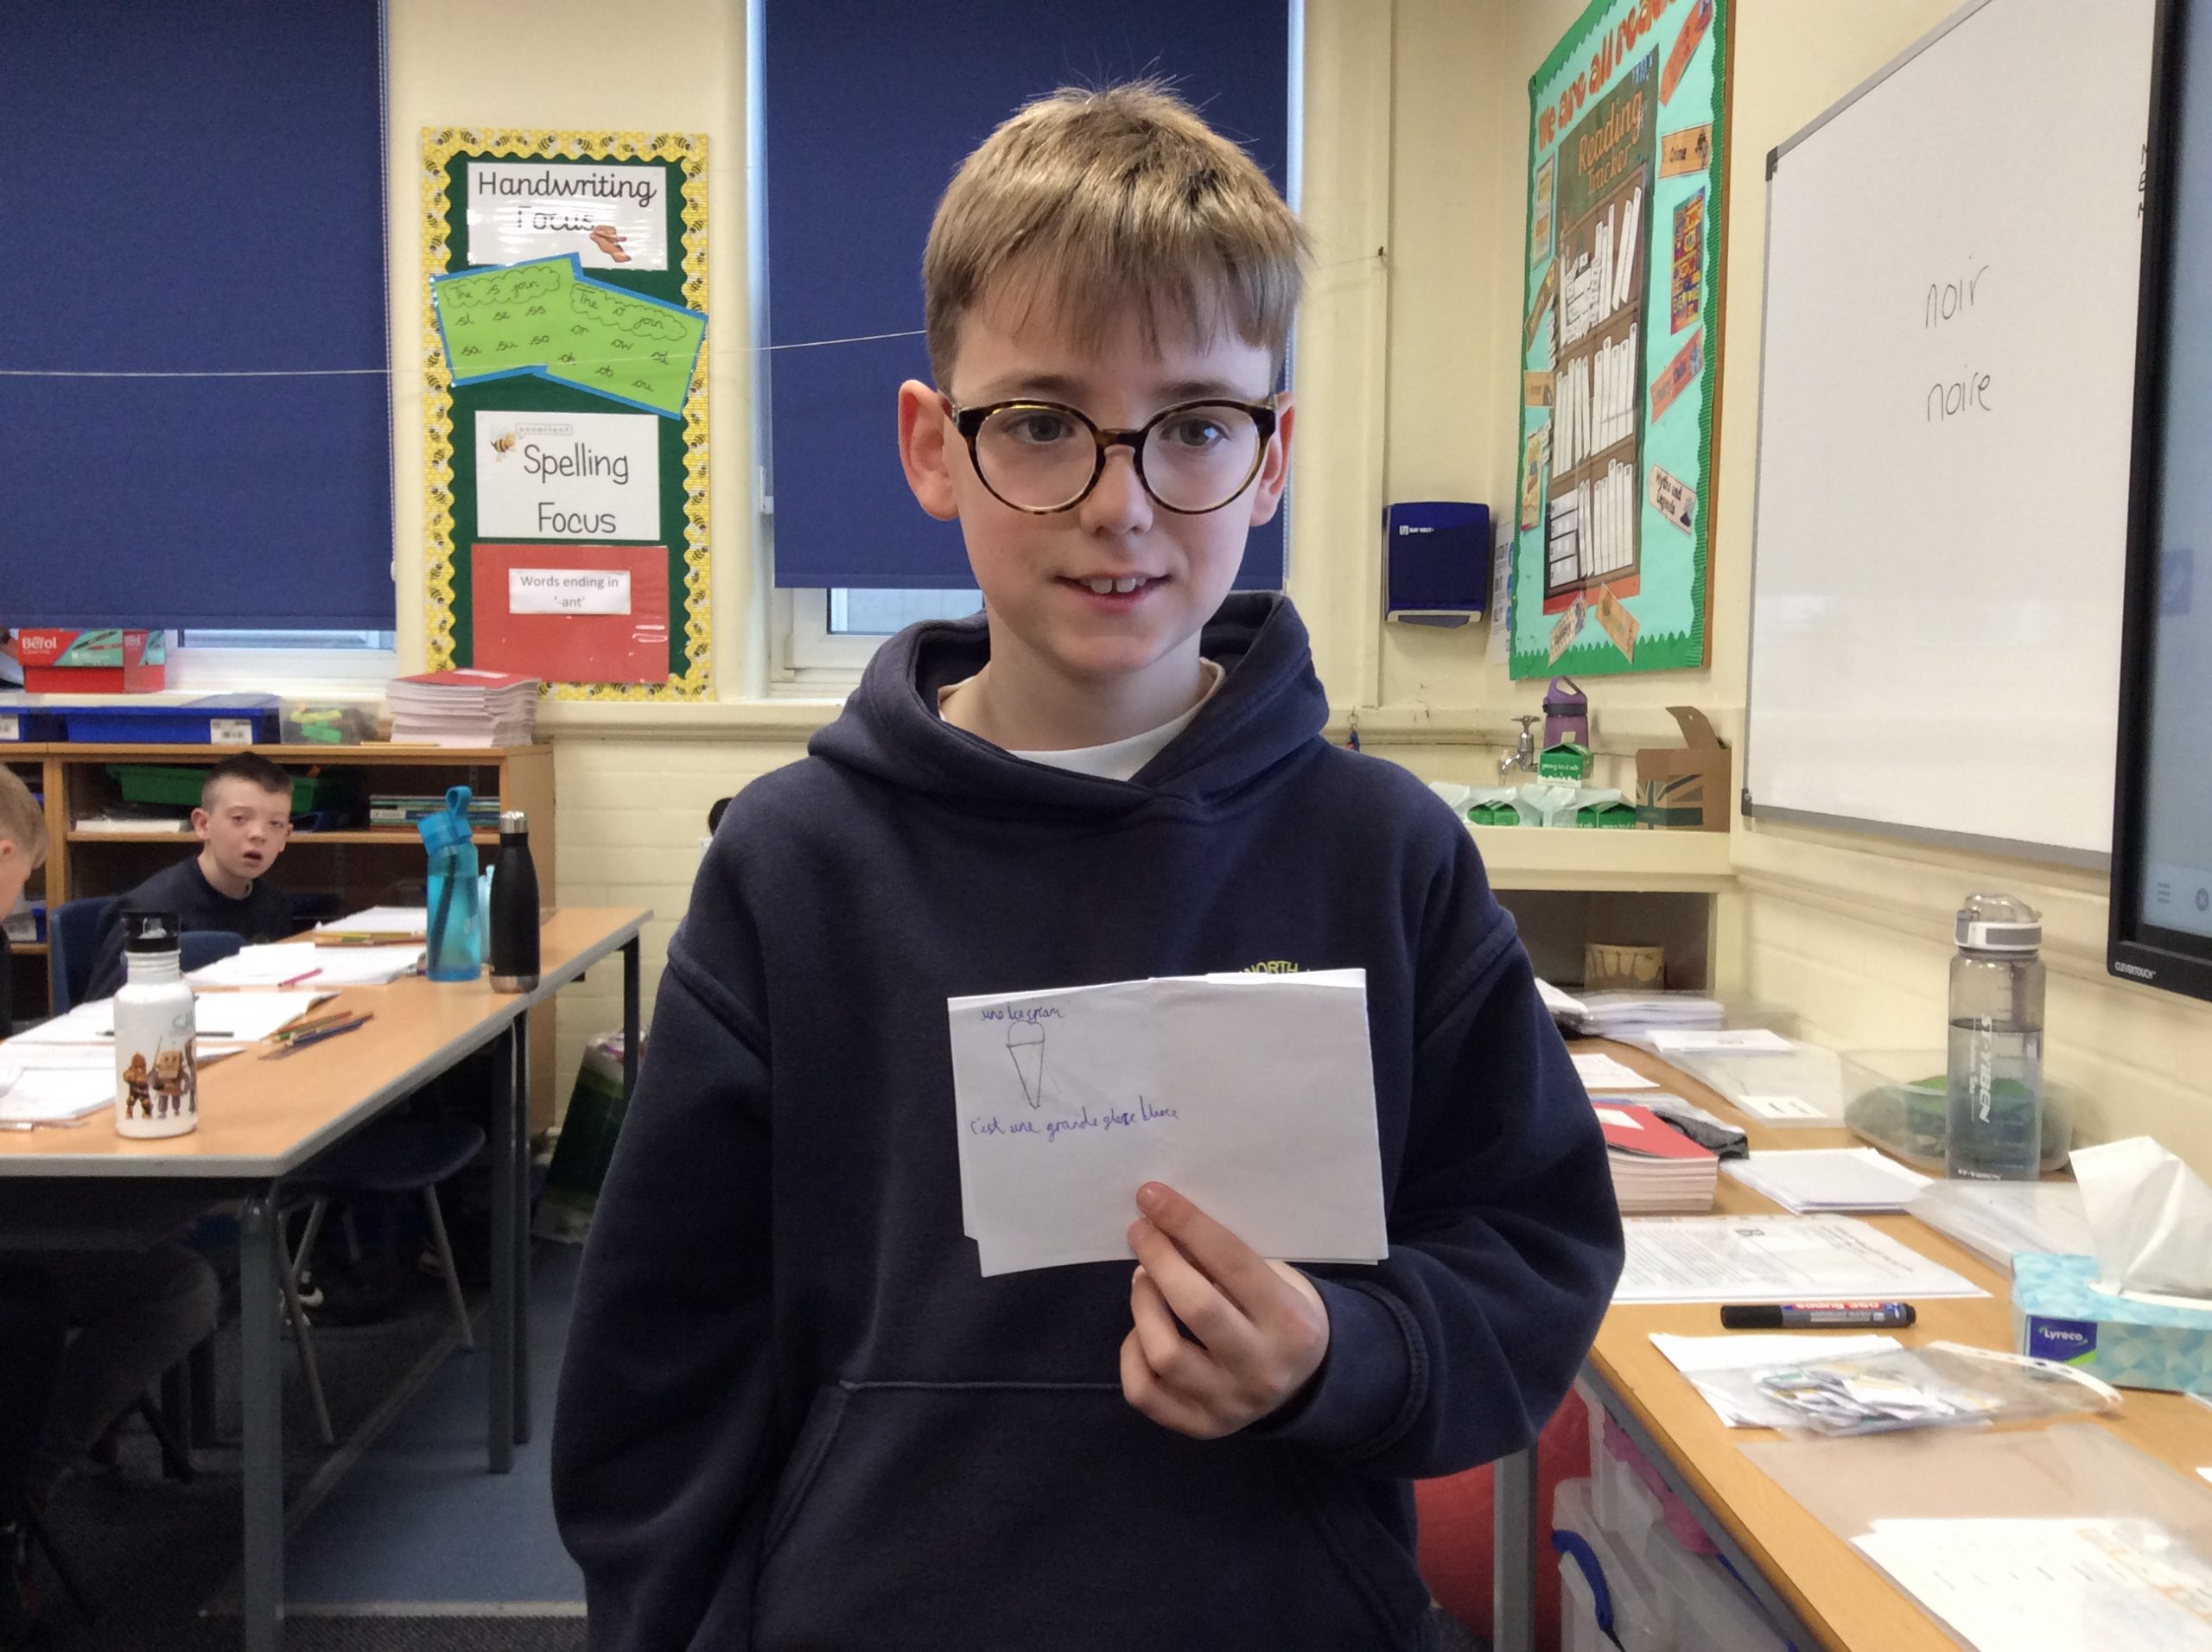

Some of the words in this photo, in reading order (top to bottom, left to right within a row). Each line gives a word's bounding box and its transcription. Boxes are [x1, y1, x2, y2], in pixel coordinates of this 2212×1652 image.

[1558, 72, 1586, 129] are
[1589, 28, 1613, 95] all
[1579, 91, 1643, 175] Reading
[479, 170, 658, 208] Handwriting
[575, 288, 598, 310] The
[1925, 255, 1990, 329] noir
[1927, 363, 1992, 423] noire
[524, 442, 630, 486] Spelling
[537, 501, 617, 534] Focus
[520, 575, 560, 588] Words
[563, 575, 605, 590] ending
[607, 576, 620, 588] in
[2044, 1329, 2083, 1342] Lyreco
